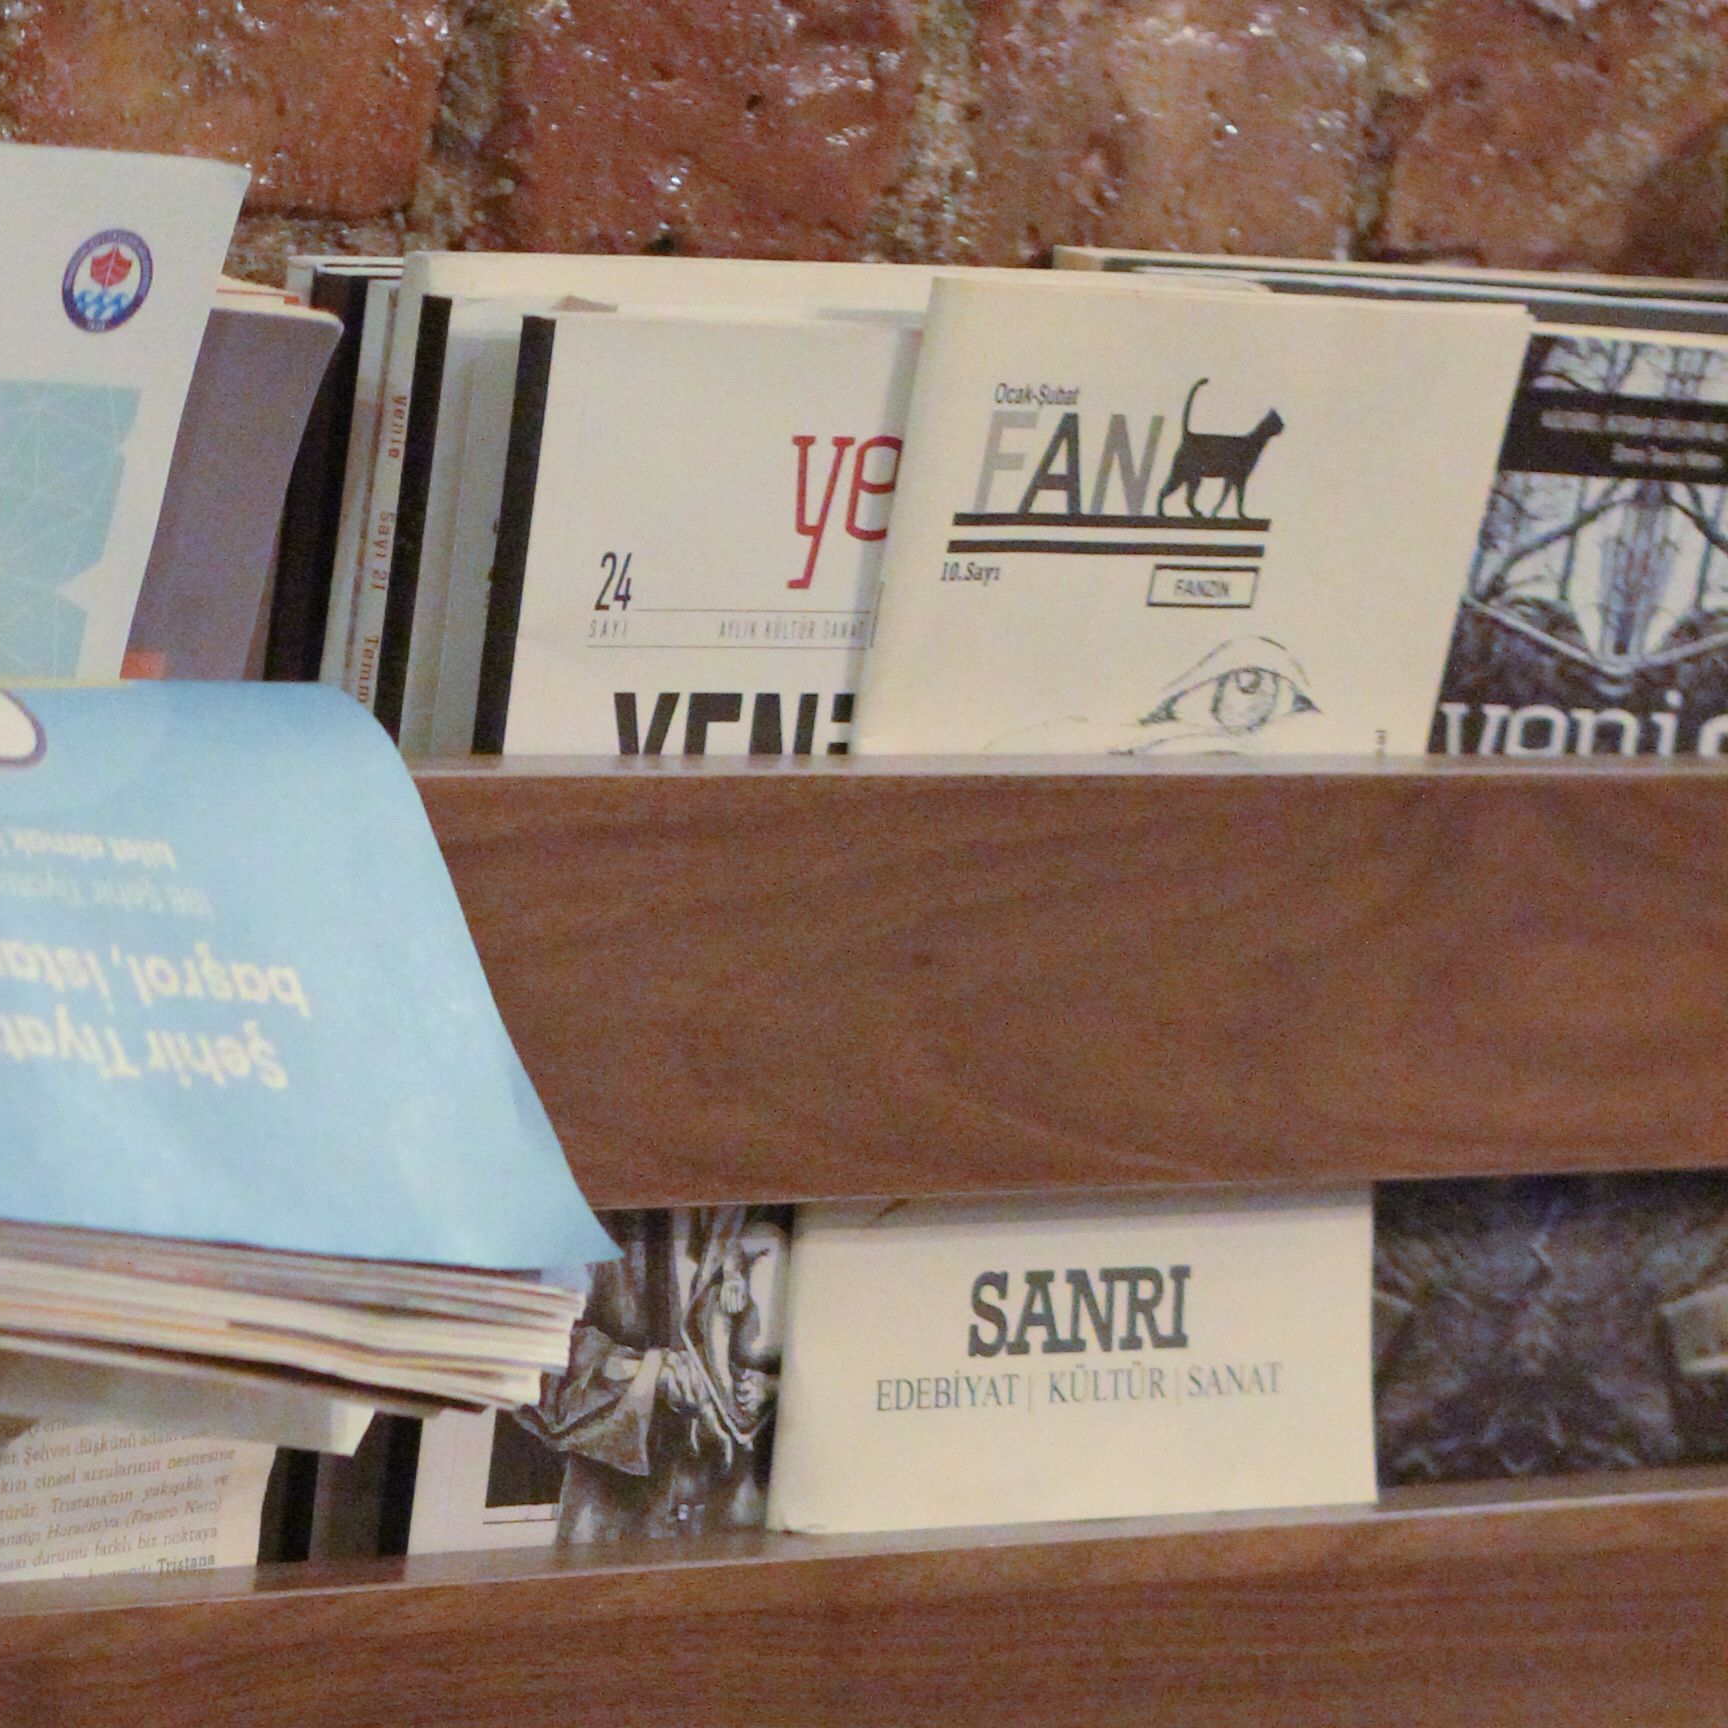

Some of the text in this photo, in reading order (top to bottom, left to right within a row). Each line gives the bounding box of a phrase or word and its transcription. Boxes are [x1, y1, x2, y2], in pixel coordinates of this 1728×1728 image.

[594, 551, 632, 611] 24
[967, 1264, 1192, 1358] SANRI
[875, 1361, 1283, 1413] EDEBİYAT KÜLTÜR SANAT
